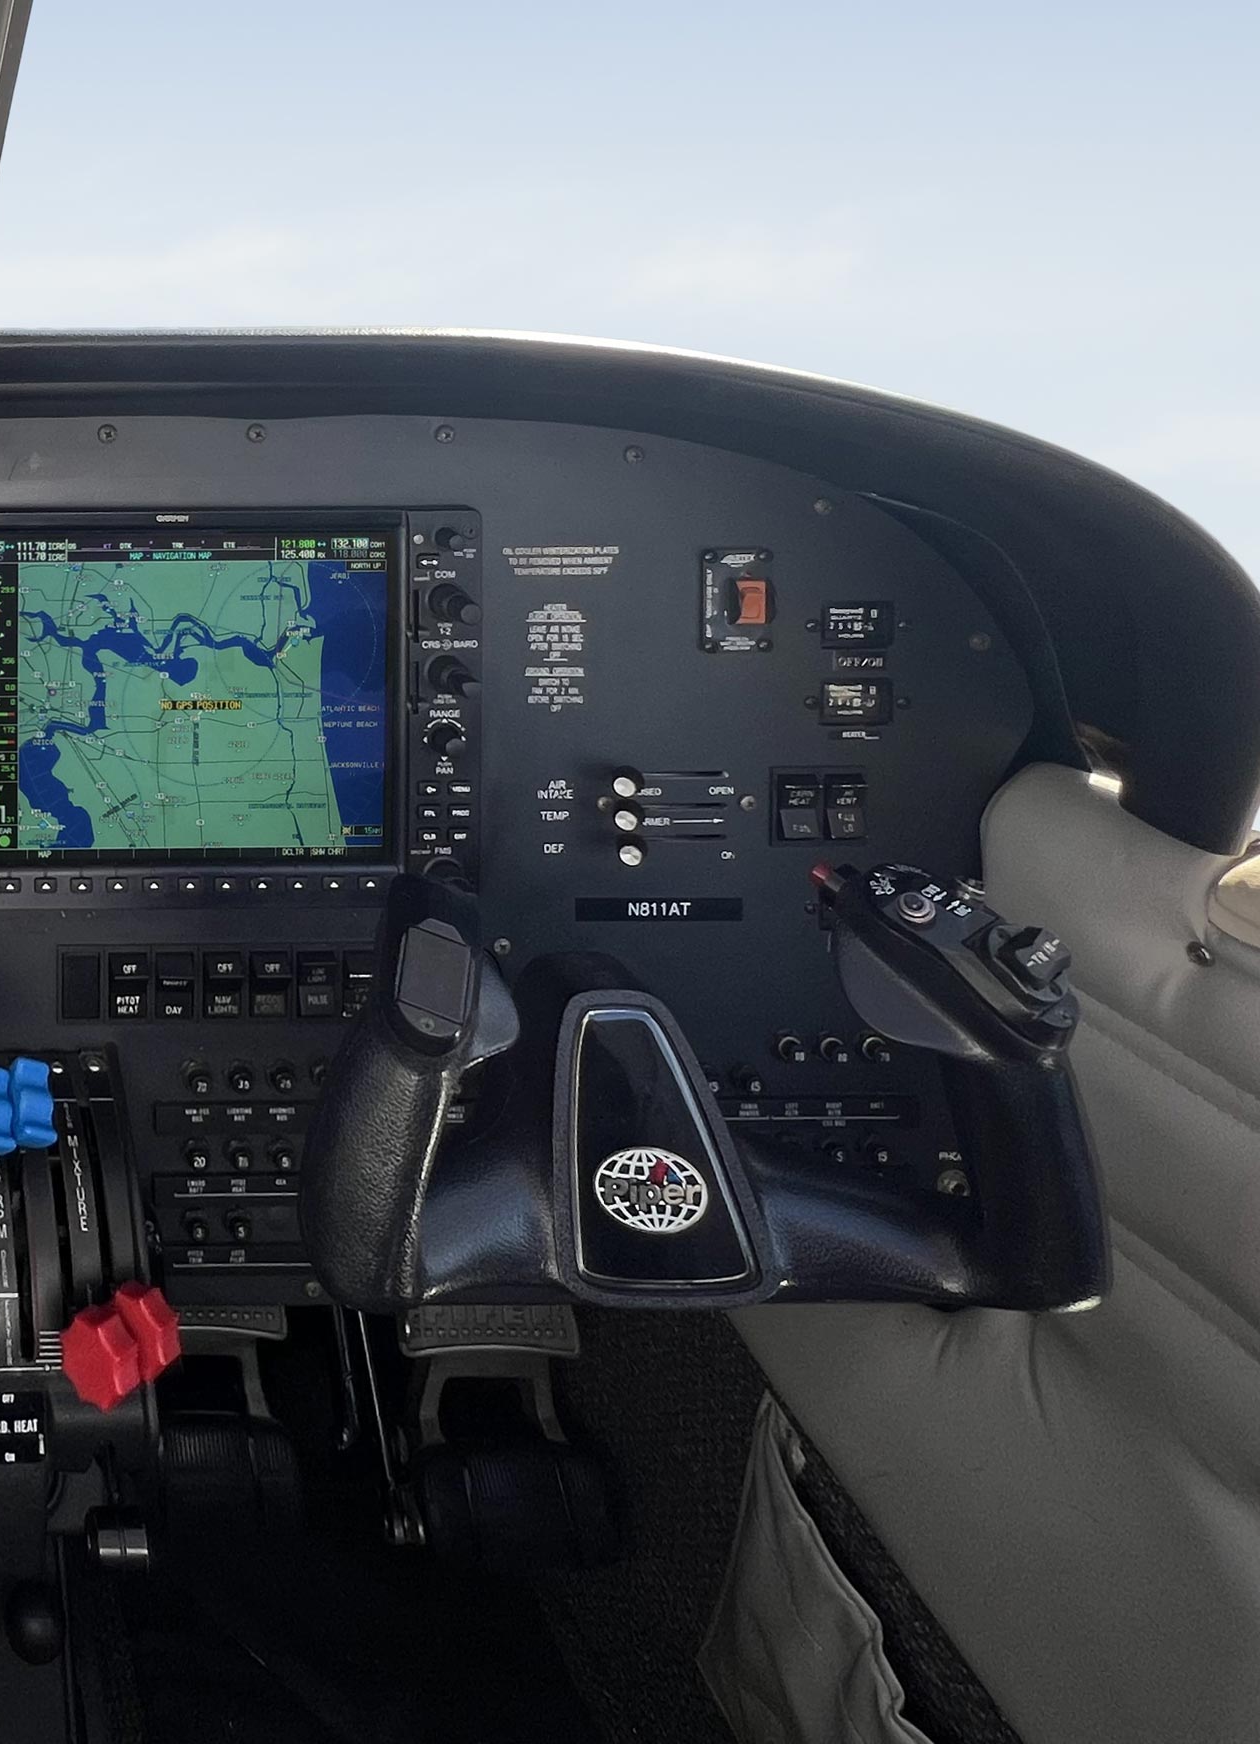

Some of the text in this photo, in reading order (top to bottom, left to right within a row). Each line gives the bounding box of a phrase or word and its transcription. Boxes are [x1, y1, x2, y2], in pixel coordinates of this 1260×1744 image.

[129, 552, 212, 560] MAP NAVIGATION MAP
[350, 562, 371, 570] NORTH
[434, 570, 456, 579] COM
[161, 701, 241, 710] NO GPS POSITION
[429, 709, 460, 718] RANGE
[435, 766, 453, 775] PAN
[547, 780, 566, 790] AIR
[536, 789, 574, 800] INTAKE
[708, 785, 735, 796] OPEN
[627, 902, 692, 917] N811AT
[116, 995, 140, 1005] PITOT
[214, 996, 232, 1005] NAV
[165, 1006, 182, 1015] DAY
[193, 1156, 206, 1168] 20
[67, 1134, 89, 1232] MIXTURE
[603, 1178, 702, 1212] Piper
[13, 1418, 38, 1434] HEAT
